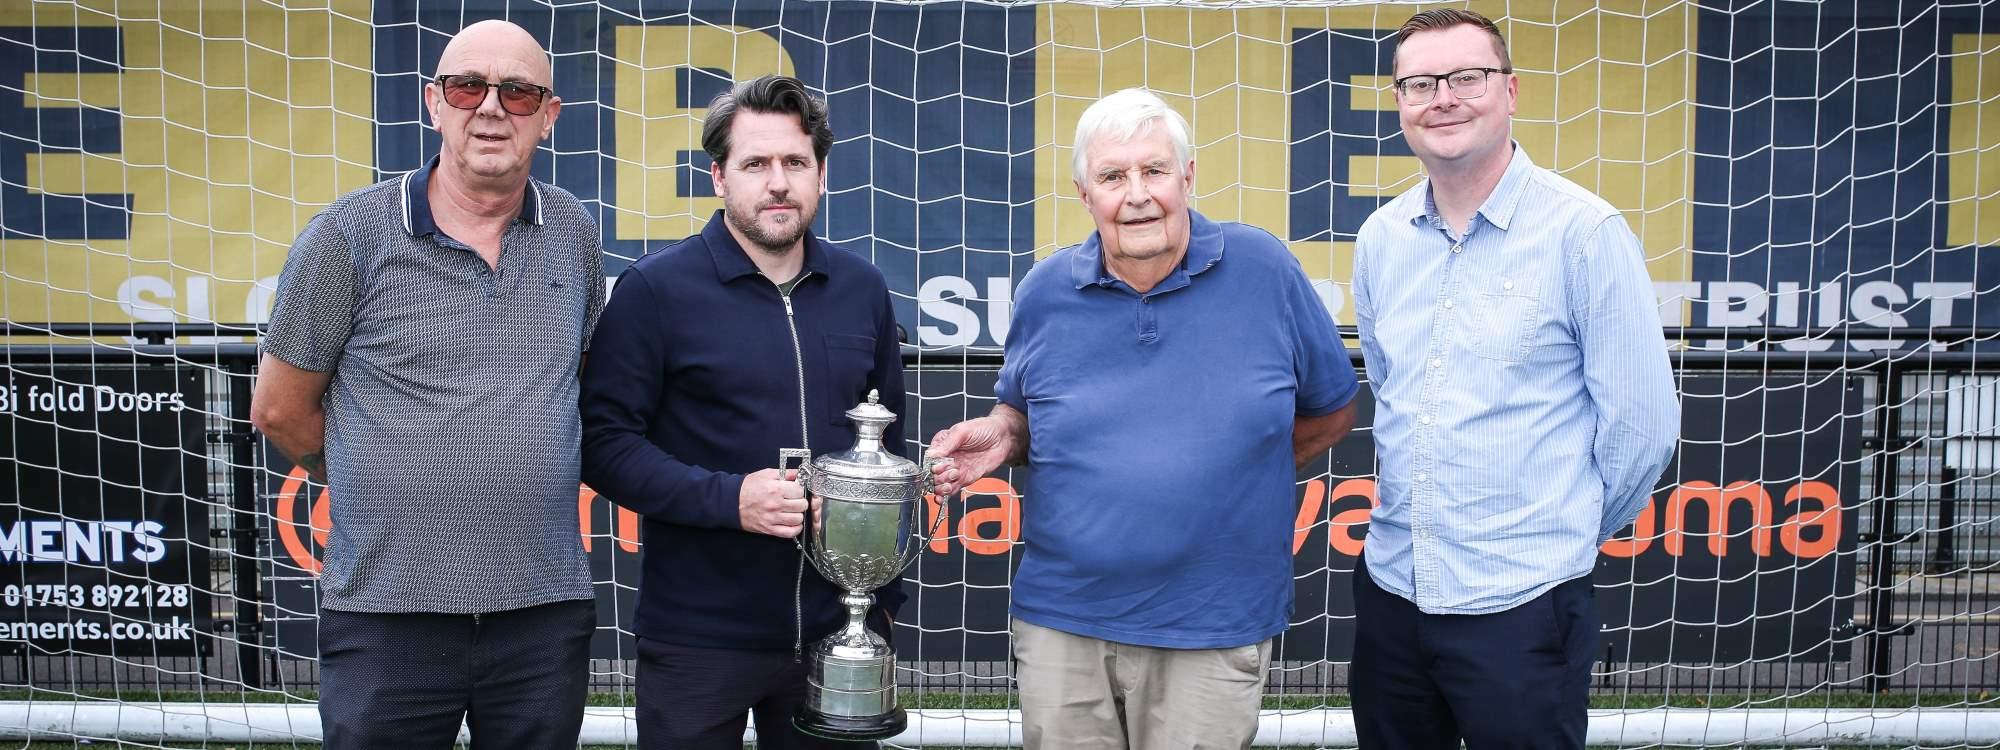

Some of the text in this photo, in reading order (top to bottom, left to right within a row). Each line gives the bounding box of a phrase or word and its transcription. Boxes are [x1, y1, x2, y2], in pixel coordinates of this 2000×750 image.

[28, 385, 85, 412] fold
[96, 385, 185, 412] Doors
[4, 584, 189, 608] 01753 892128
